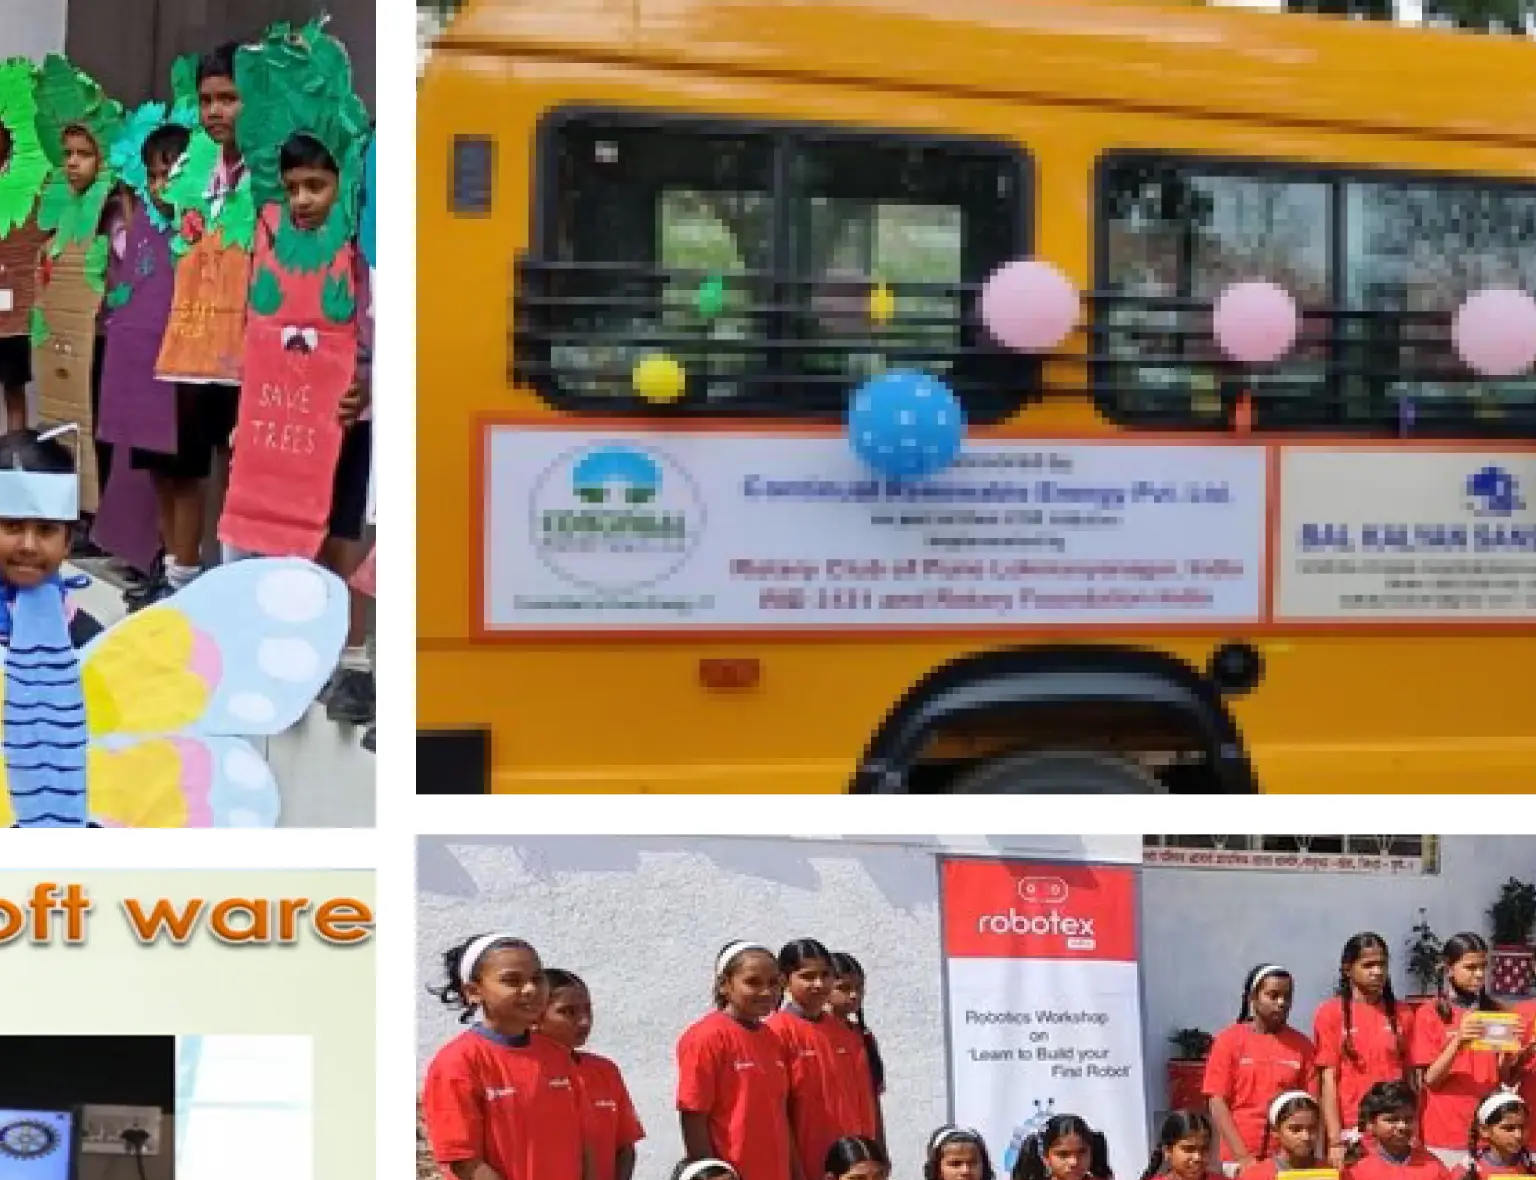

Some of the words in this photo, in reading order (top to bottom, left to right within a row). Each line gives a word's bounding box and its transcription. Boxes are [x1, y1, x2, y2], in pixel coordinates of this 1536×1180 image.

[258, 382, 312, 414] SAVE
[250, 419, 316, 454] TREES
[978, 907, 1096, 936] robotex
[965, 1010, 1032, 1025] Robotics
[1035, 1010, 1110, 1027] Workshop
[1029, 1030, 1050, 1043] on
[1018, 1047, 1034, 1061] to
[1037, 1047, 1075, 1061] Build
[1078, 1049, 1111, 1063] your
